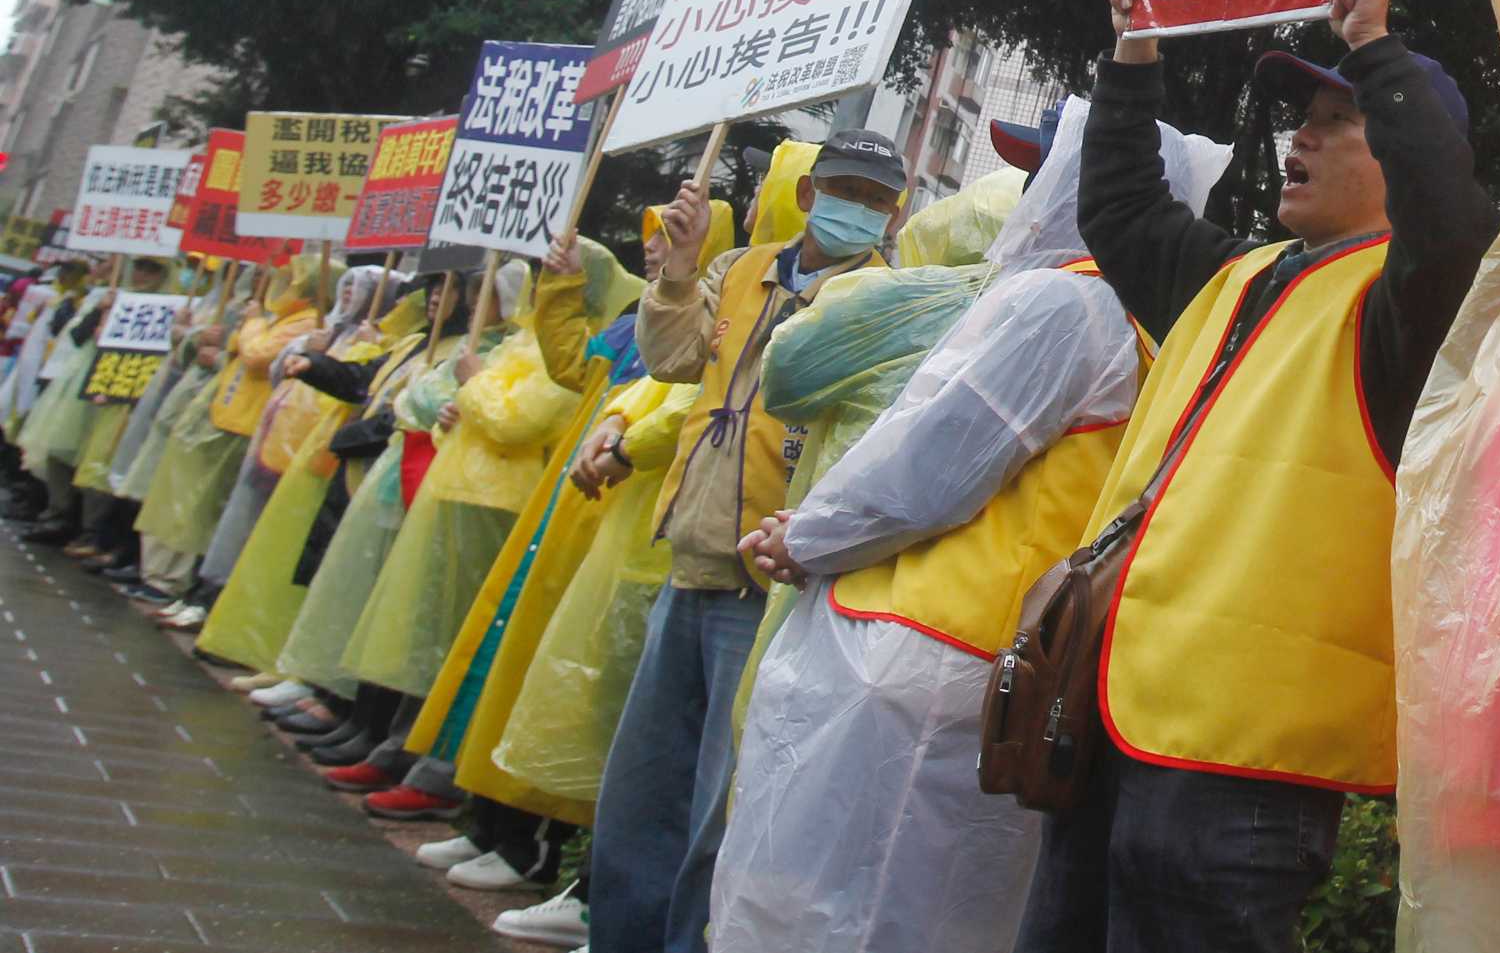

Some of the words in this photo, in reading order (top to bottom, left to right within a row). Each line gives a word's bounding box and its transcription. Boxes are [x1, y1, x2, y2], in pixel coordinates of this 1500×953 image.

[465, 55, 587, 142] 法稅改革
[272, 117, 386, 144] 濫開稅
[841, 141, 893, 158] NCIS
[439, 150, 570, 244] 終結稅災
